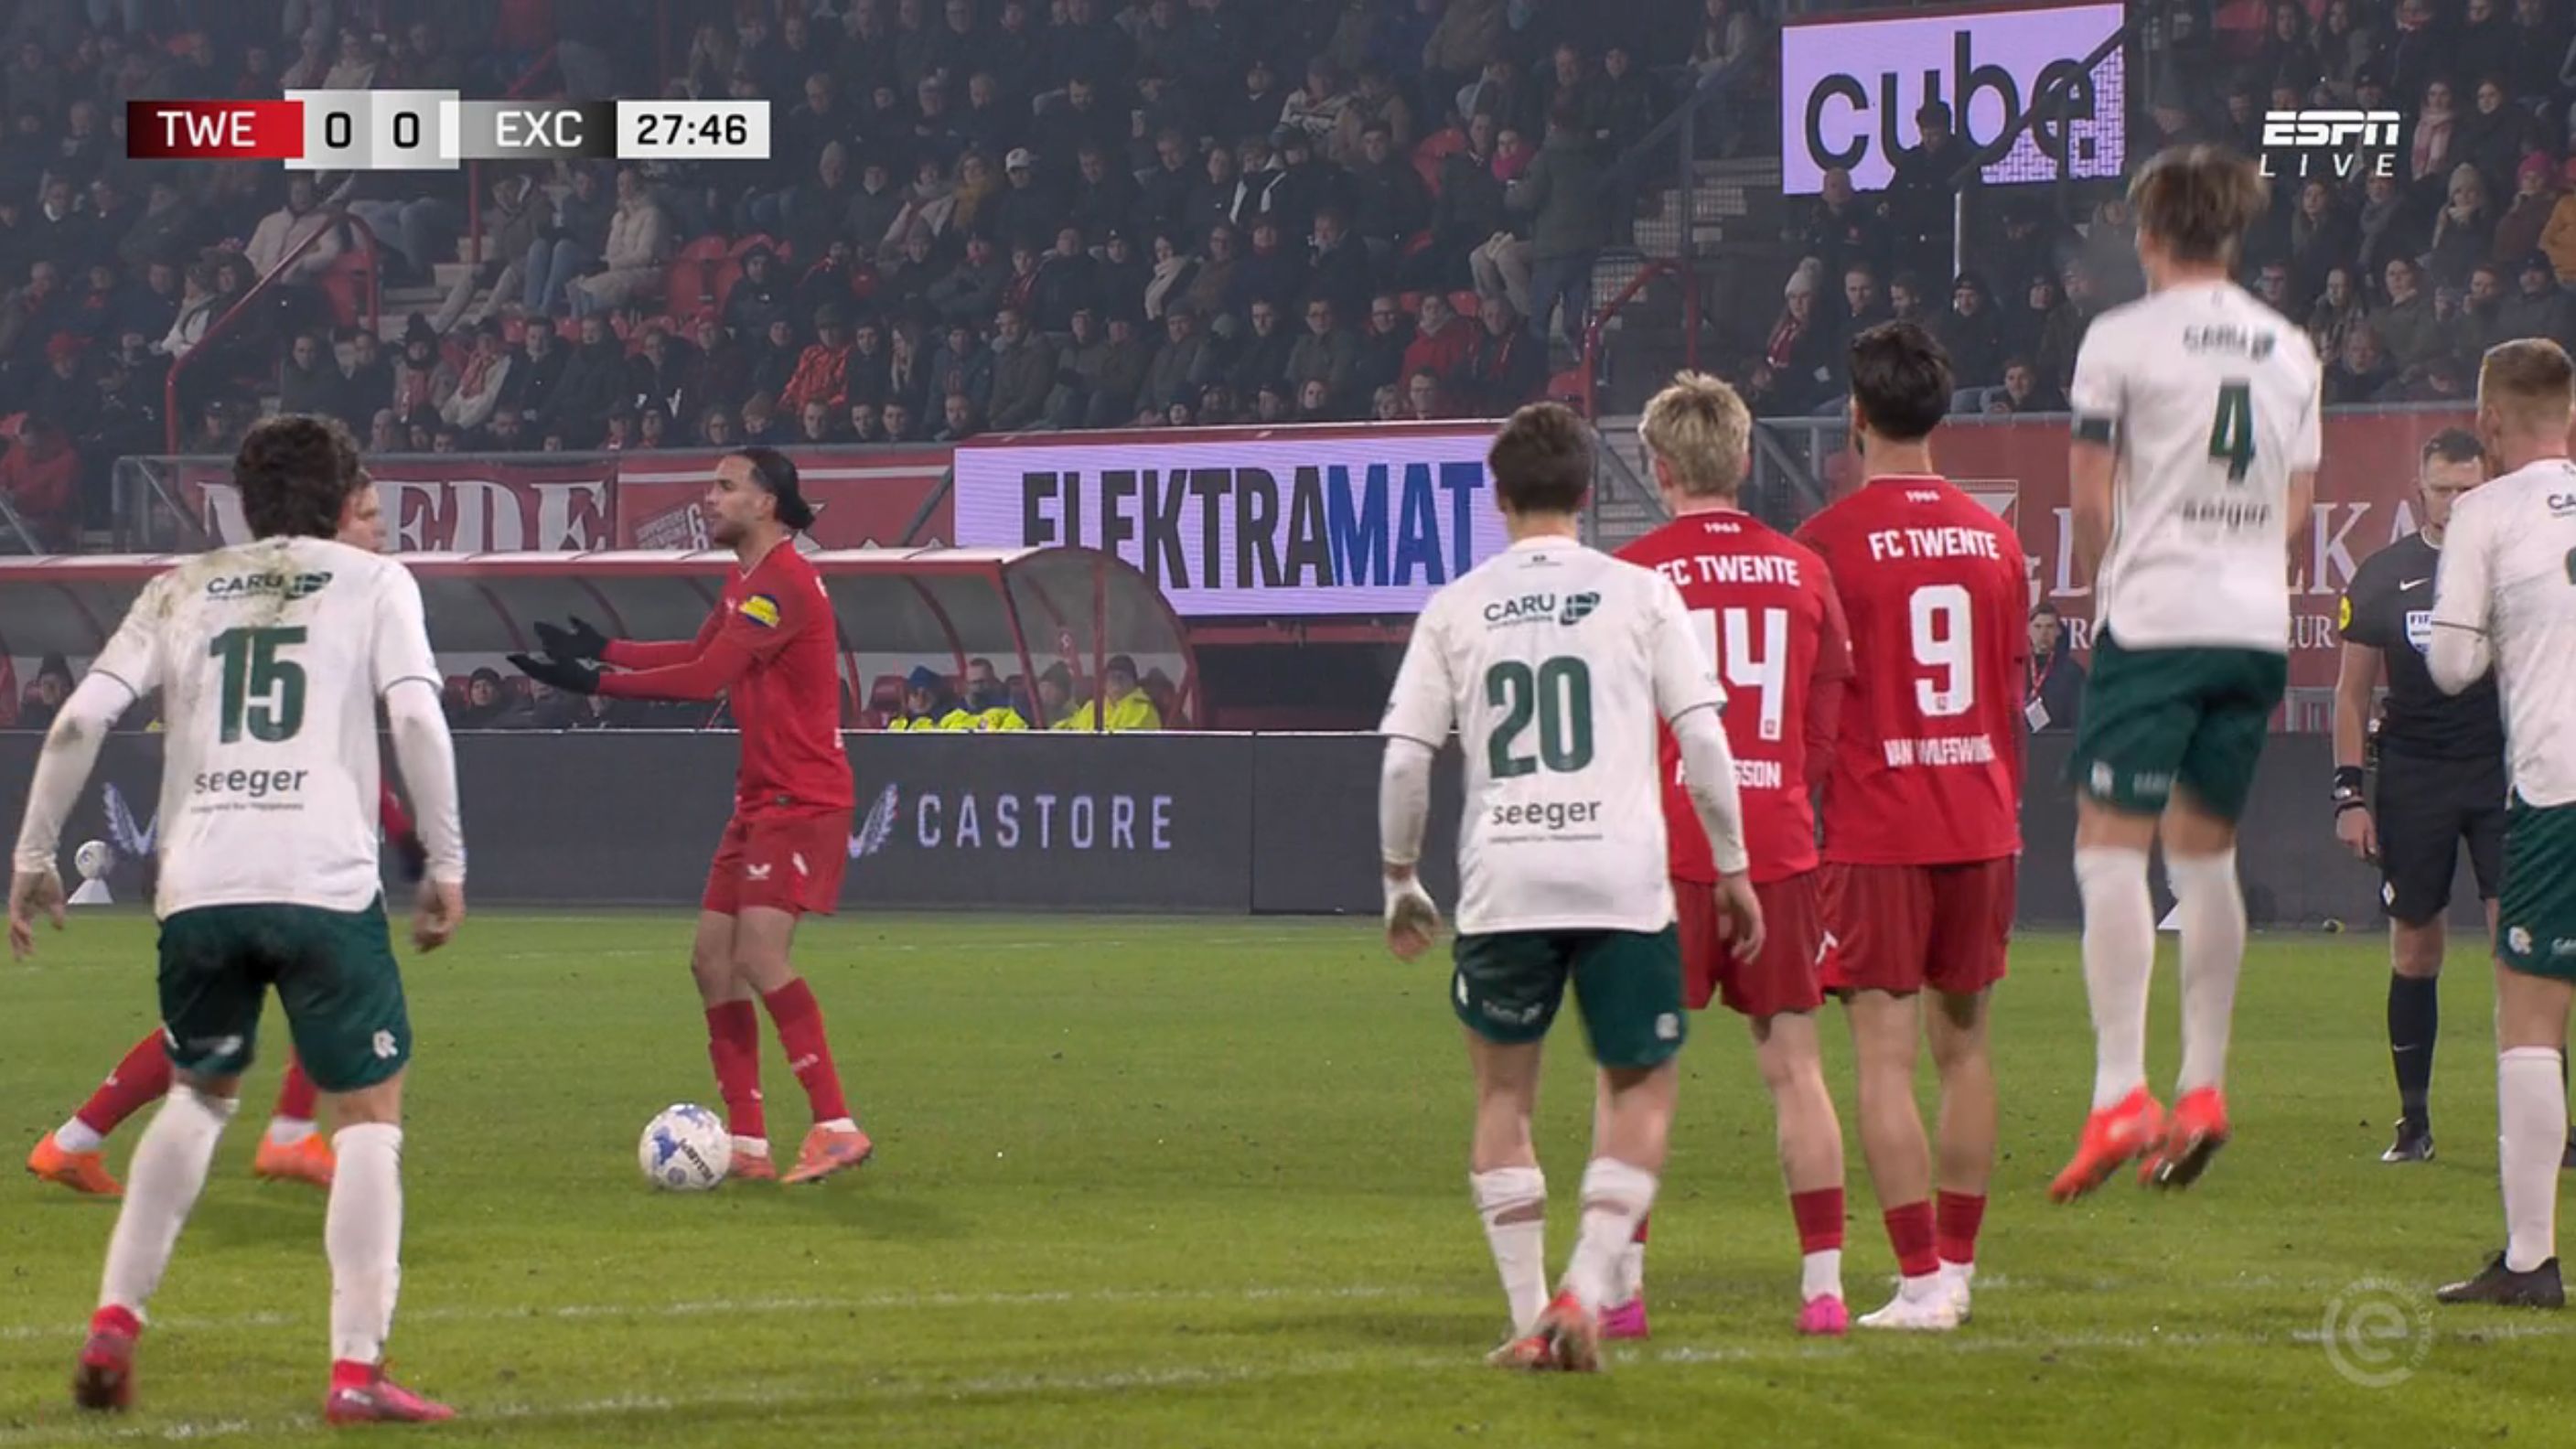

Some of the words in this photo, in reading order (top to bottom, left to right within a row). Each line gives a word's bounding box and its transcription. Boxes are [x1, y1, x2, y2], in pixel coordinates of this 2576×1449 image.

[1805, 30, 2096, 172] cube
[2207, 377, 2257, 487] 4
[1694, 555, 1801, 587] TWENTE
[1868, 531, 1905, 562] FC
[1905, 526, 2001, 560] TWENTE
[207, 574, 284, 593] CARU
[1484, 593, 1555, 622] CARU
[1686, 607, 1788, 740] 14
[1909, 585, 1974, 716] 9
[209, 625, 307, 745] 15
[1485, 655, 1594, 779] 20
[194, 769, 308, 798] seeger
[918, 793, 1172, 849] CASTORE
[1492, 801, 1602, 830] seeger
